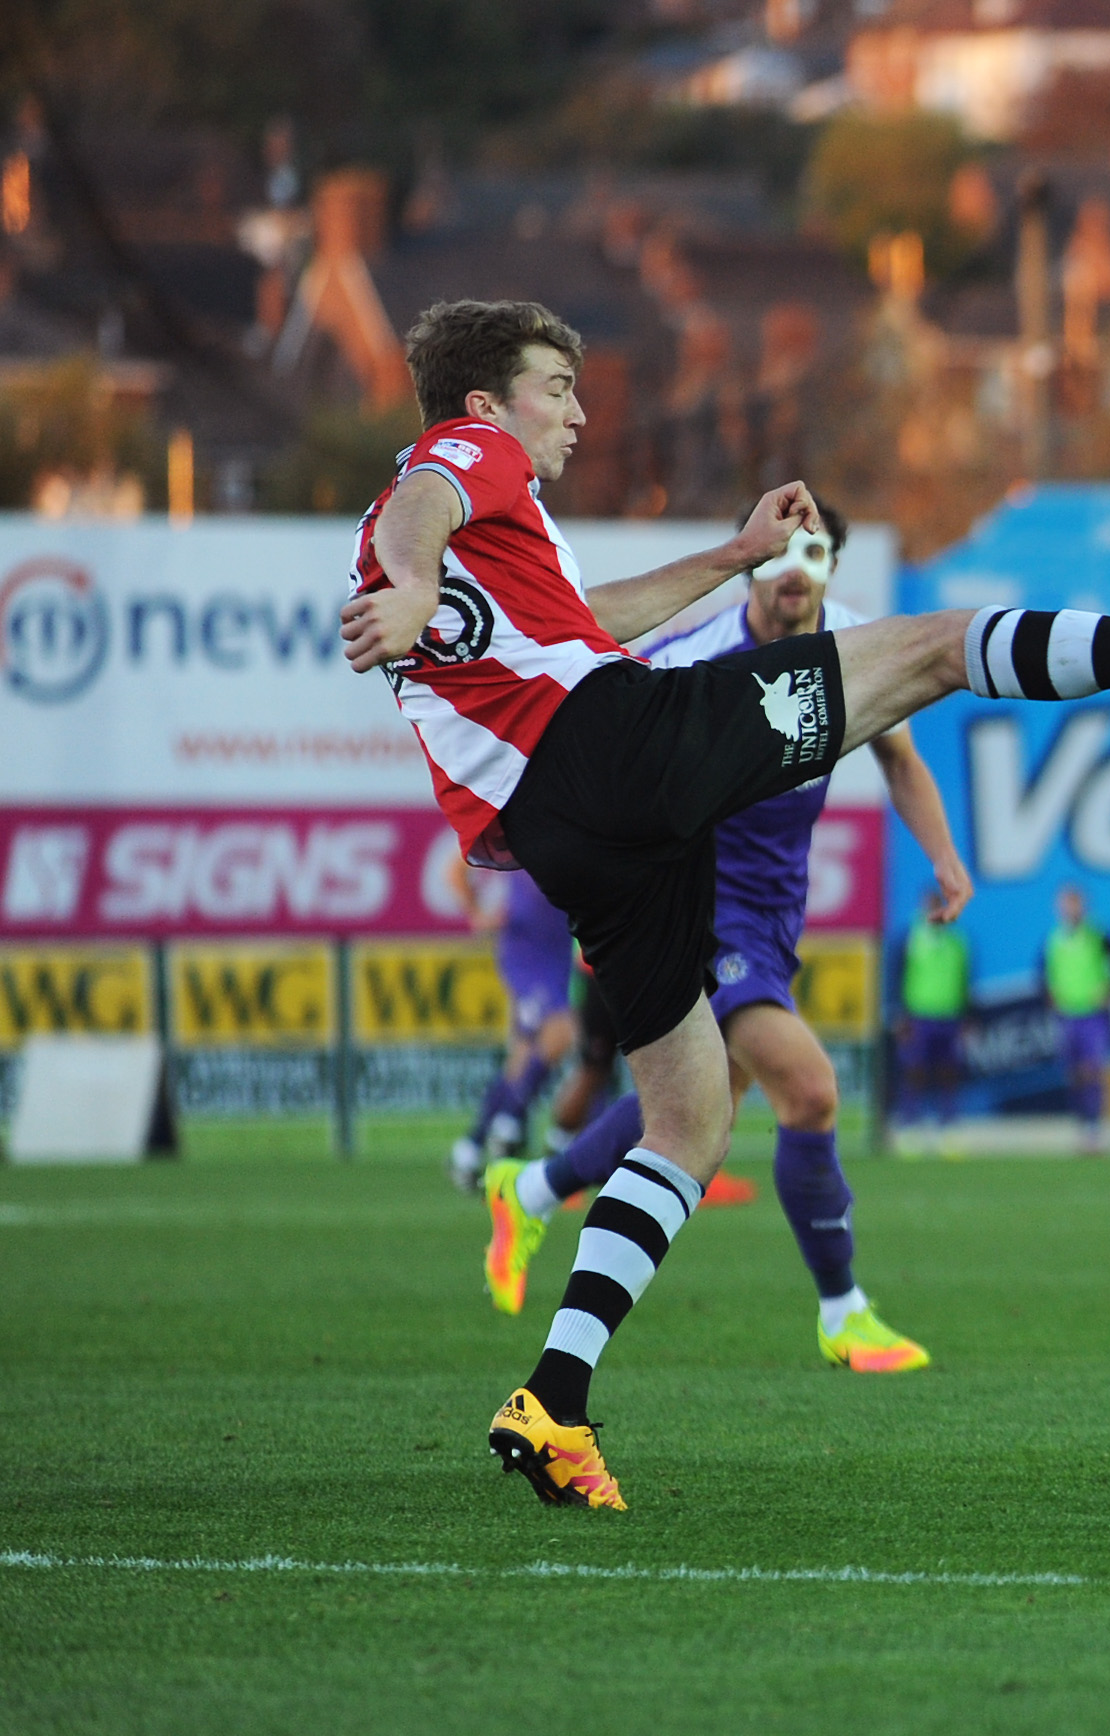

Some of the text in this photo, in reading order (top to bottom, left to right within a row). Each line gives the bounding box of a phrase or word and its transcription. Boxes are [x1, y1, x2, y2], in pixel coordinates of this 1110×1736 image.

[794, 668, 818, 764] UNICORN
[813, 667, 828, 725] SOMERTON
[781, 743, 795, 768] THE
[98, 822, 394, 922] SIGNS
